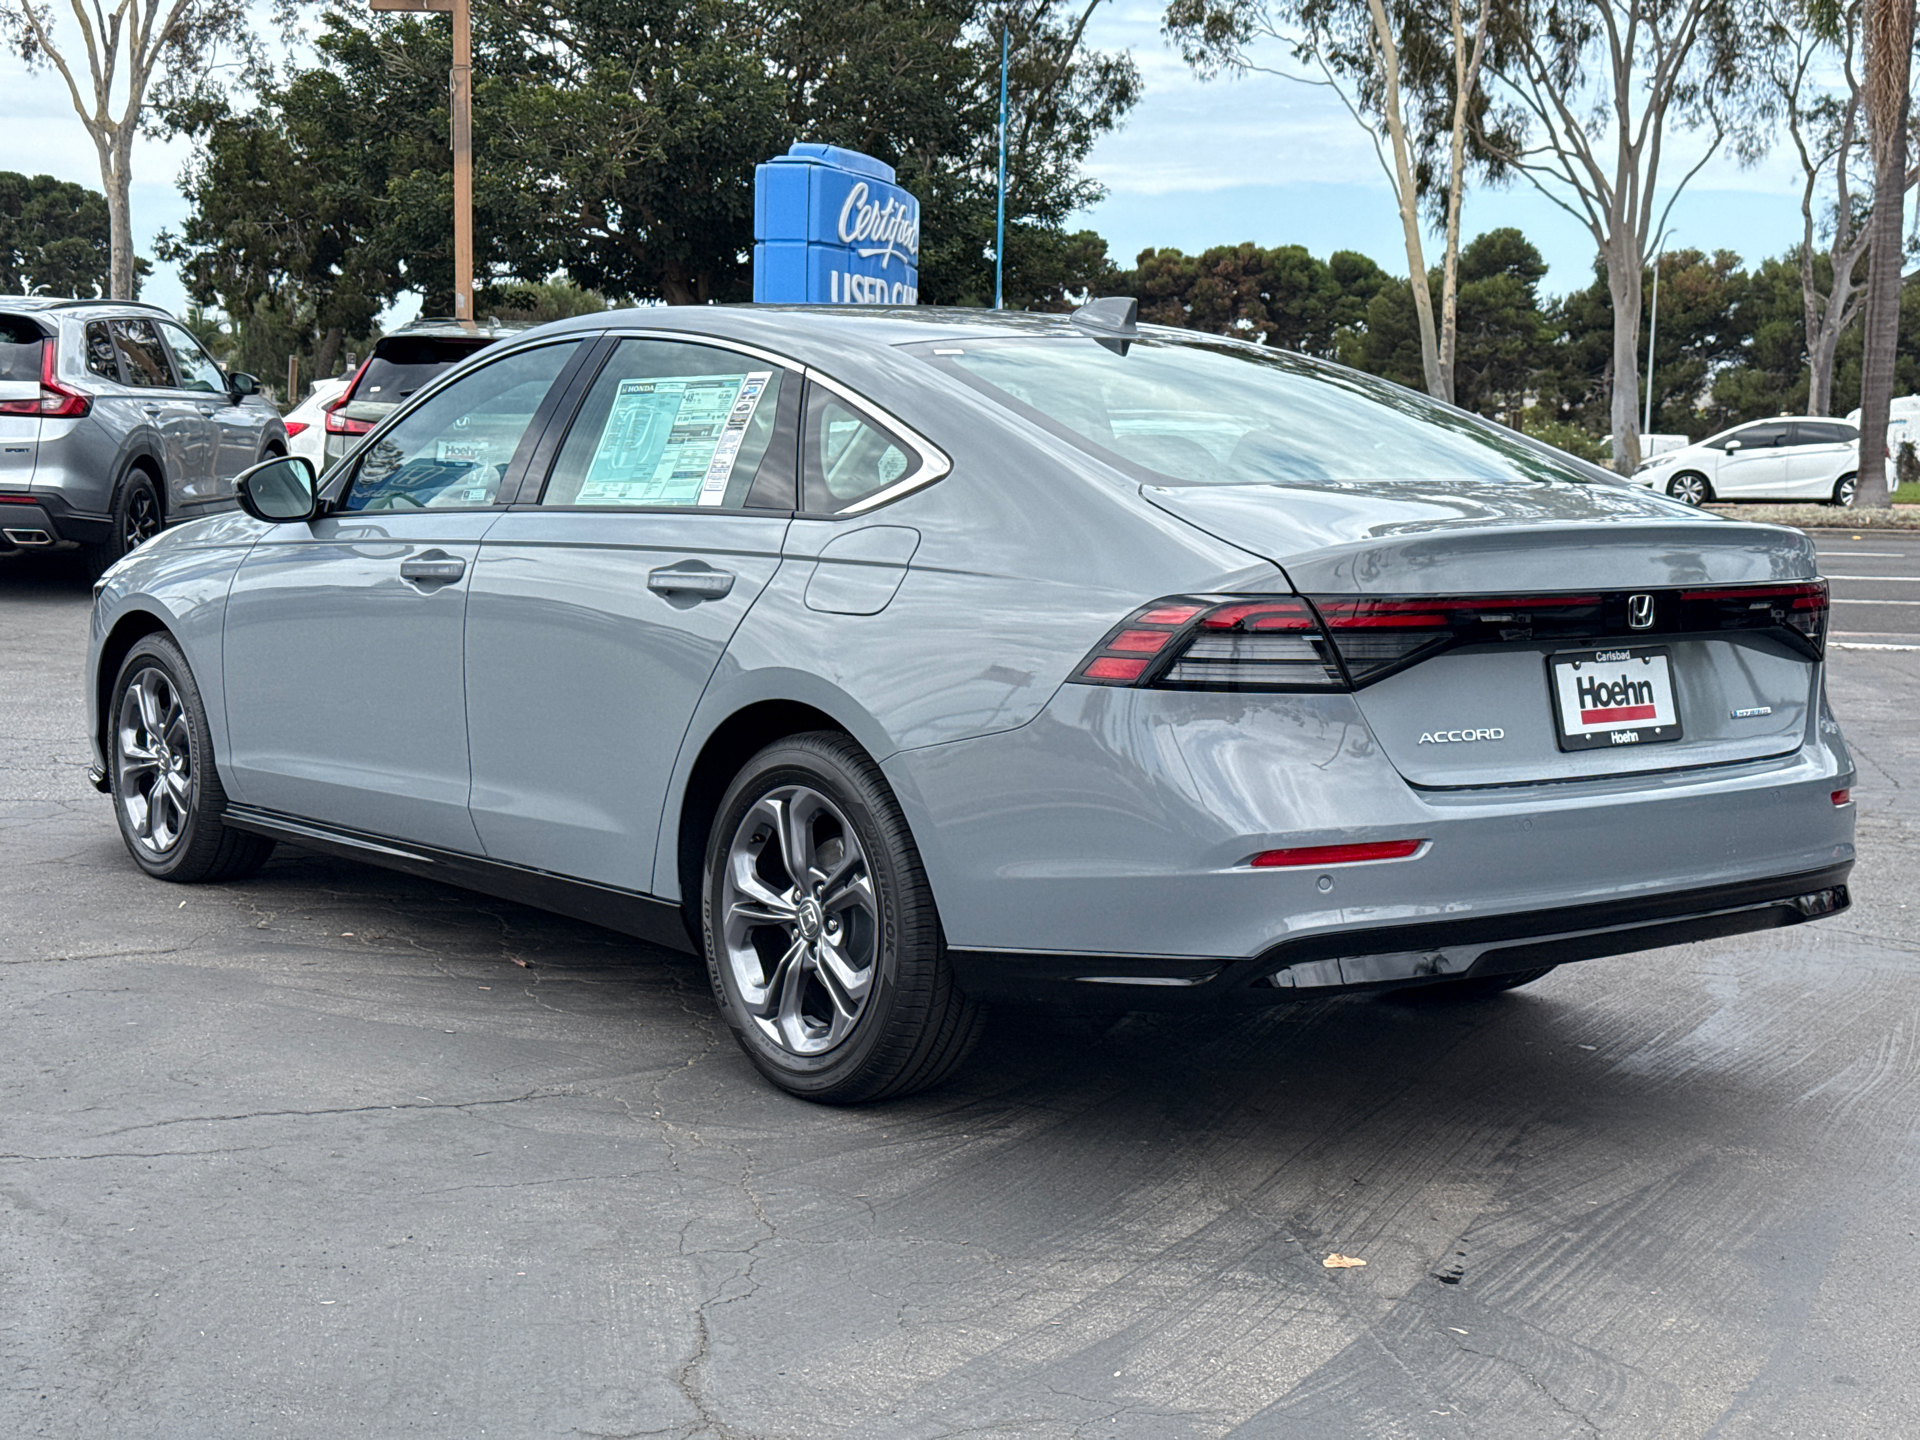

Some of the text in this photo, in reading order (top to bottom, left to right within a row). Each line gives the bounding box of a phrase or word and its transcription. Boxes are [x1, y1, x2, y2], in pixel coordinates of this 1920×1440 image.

[838, 182, 918, 269] Certified
[831, 270, 889, 304] USED
[628, 384, 655, 393] HONDA
[1595, 650, 1631, 662] Carlsbad
[1576, 674, 1655, 709] Hoehn
[1418, 728, 1505, 745] ACCORD
[1611, 730, 1639, 744] Hoehn
